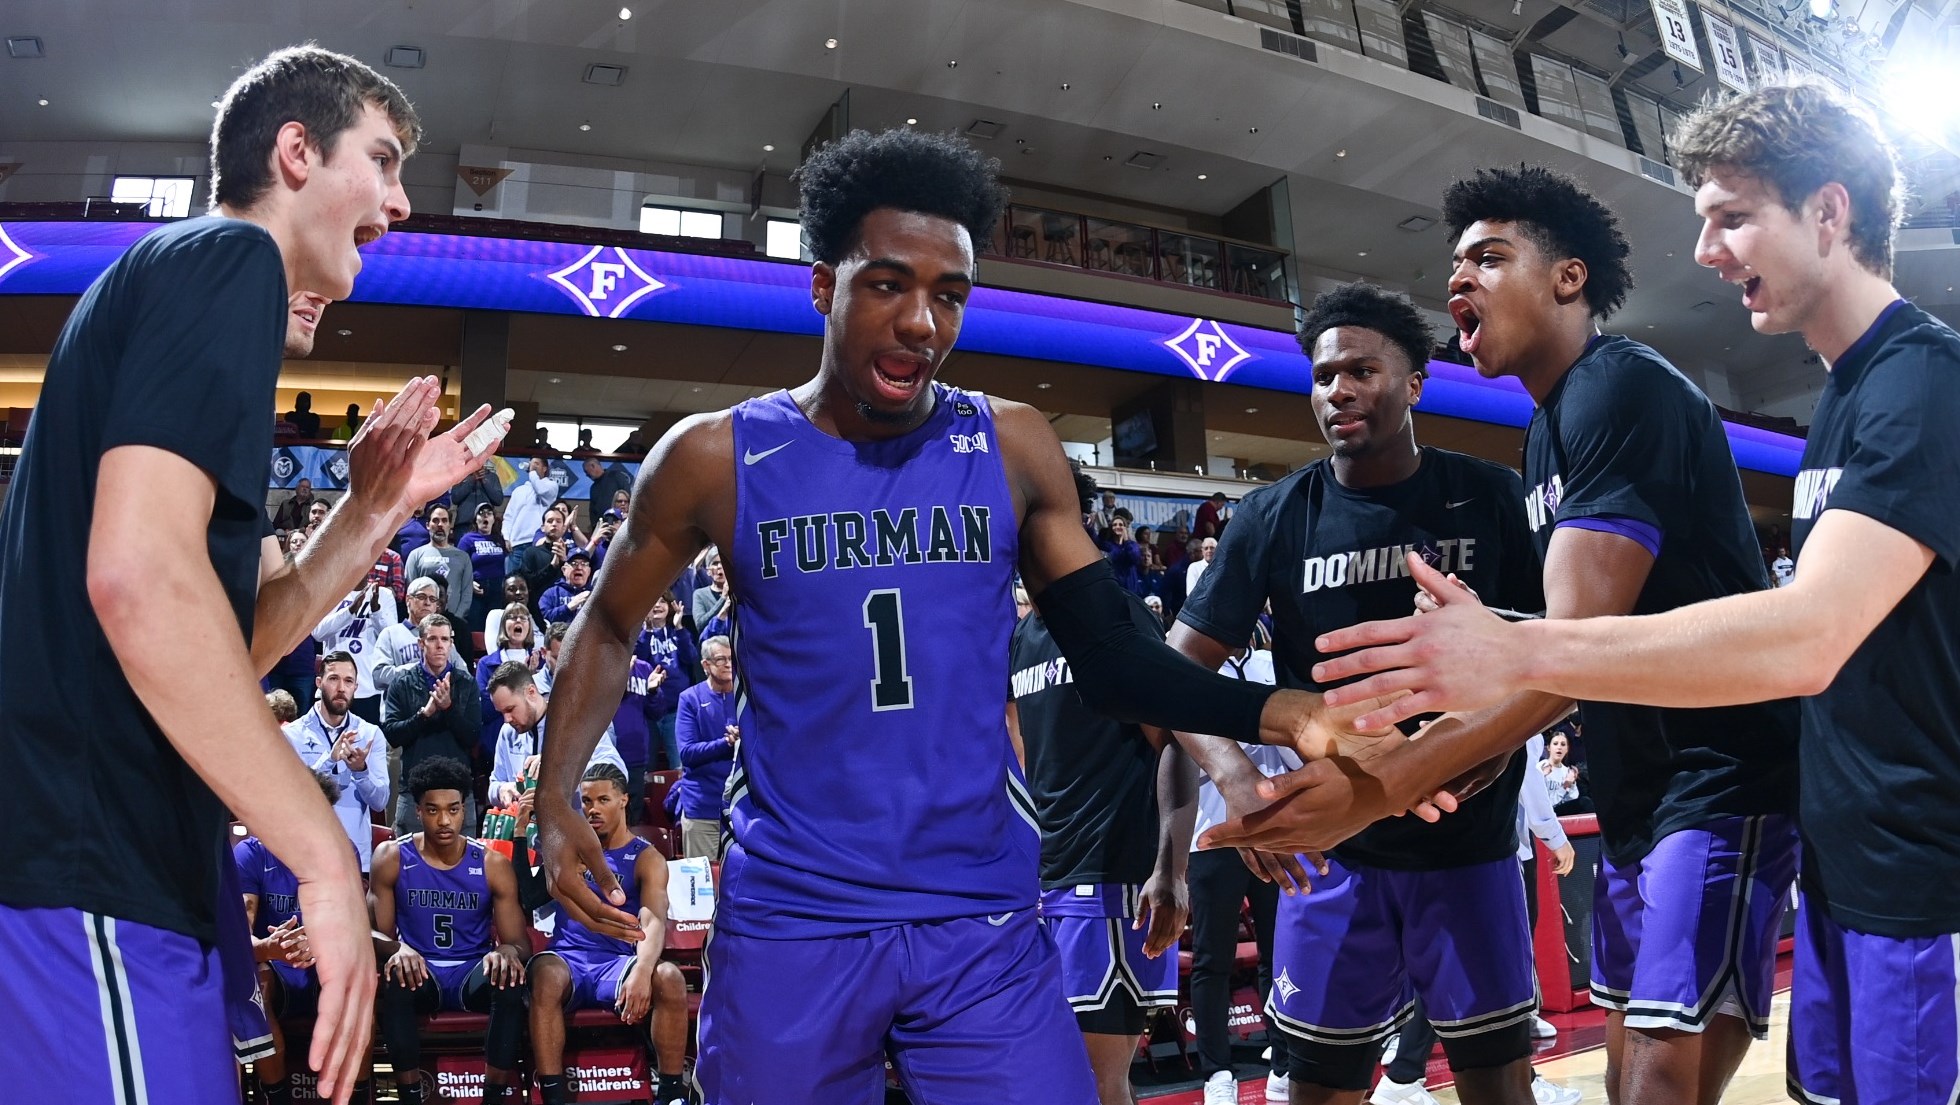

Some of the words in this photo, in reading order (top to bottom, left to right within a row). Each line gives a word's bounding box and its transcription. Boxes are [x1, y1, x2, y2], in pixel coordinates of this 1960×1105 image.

[1665, 16, 1686, 43] 13
[1718, 43, 1737, 69] 15
[472, 176, 492, 186] 211
[588, 261, 626, 300] F
[1194, 332, 1222, 367] F
[949, 431, 989, 454] SOCON
[757, 504, 992, 580] FURMAN
[862, 588, 914, 713] 1
[407, 889, 479, 910] FURMAN
[433, 914, 453, 949] 5
[565, 1065, 633, 1079] Shriners
[567, 1077, 642, 1093] Children's
